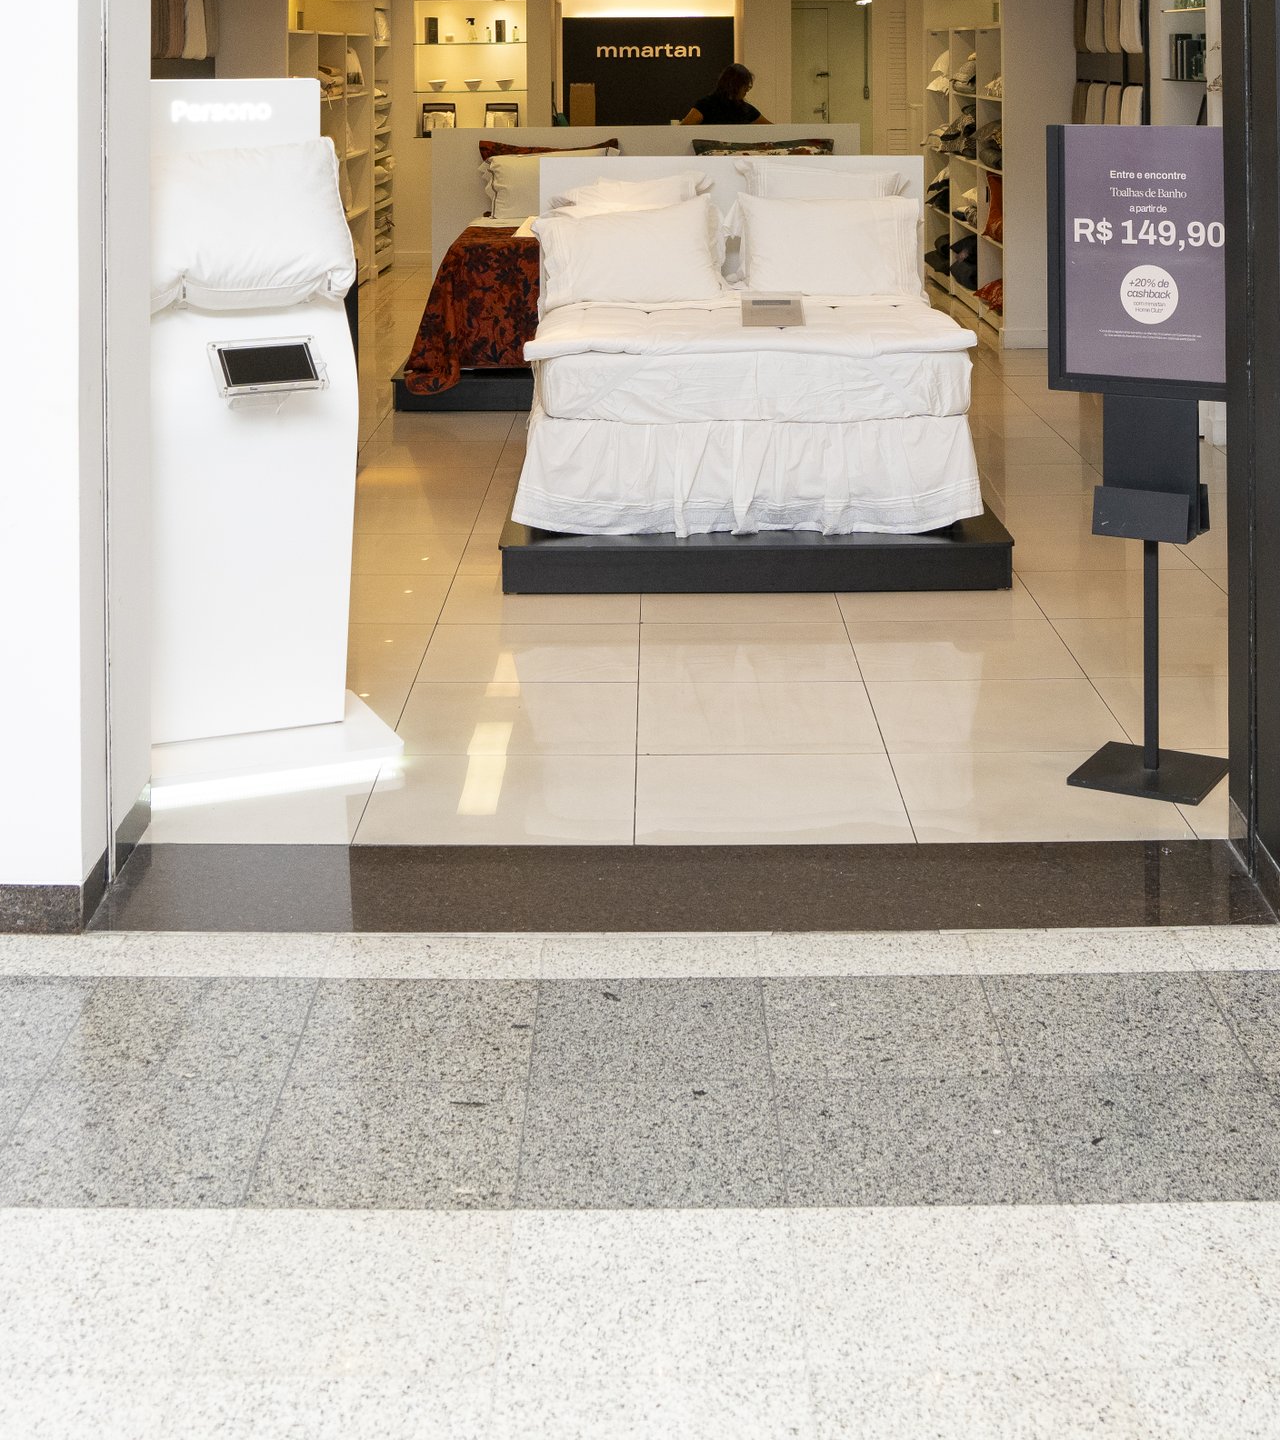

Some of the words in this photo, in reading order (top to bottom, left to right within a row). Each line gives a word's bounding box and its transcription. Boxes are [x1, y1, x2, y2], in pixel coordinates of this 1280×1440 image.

[596, 43, 701, 58] mmartan
[1109, 170, 1135, 179] Entre
[1144, 171, 1187, 180] encontre
[1109, 186, 1144, 198] Toalhas
[1145, 188, 1157, 198] de
[1157, 188, 1188, 199] Banho
[1136, 204, 1156, 214] partir
[1156, 205, 1168, 214] de
[1073, 217, 1114, 246] R$
[1121, 219, 1225, 252] 149,90
[1128, 277, 1156, 288] +20%
[1157, 278, 1170, 288] de
[1126, 289, 1172, 300] cashback
